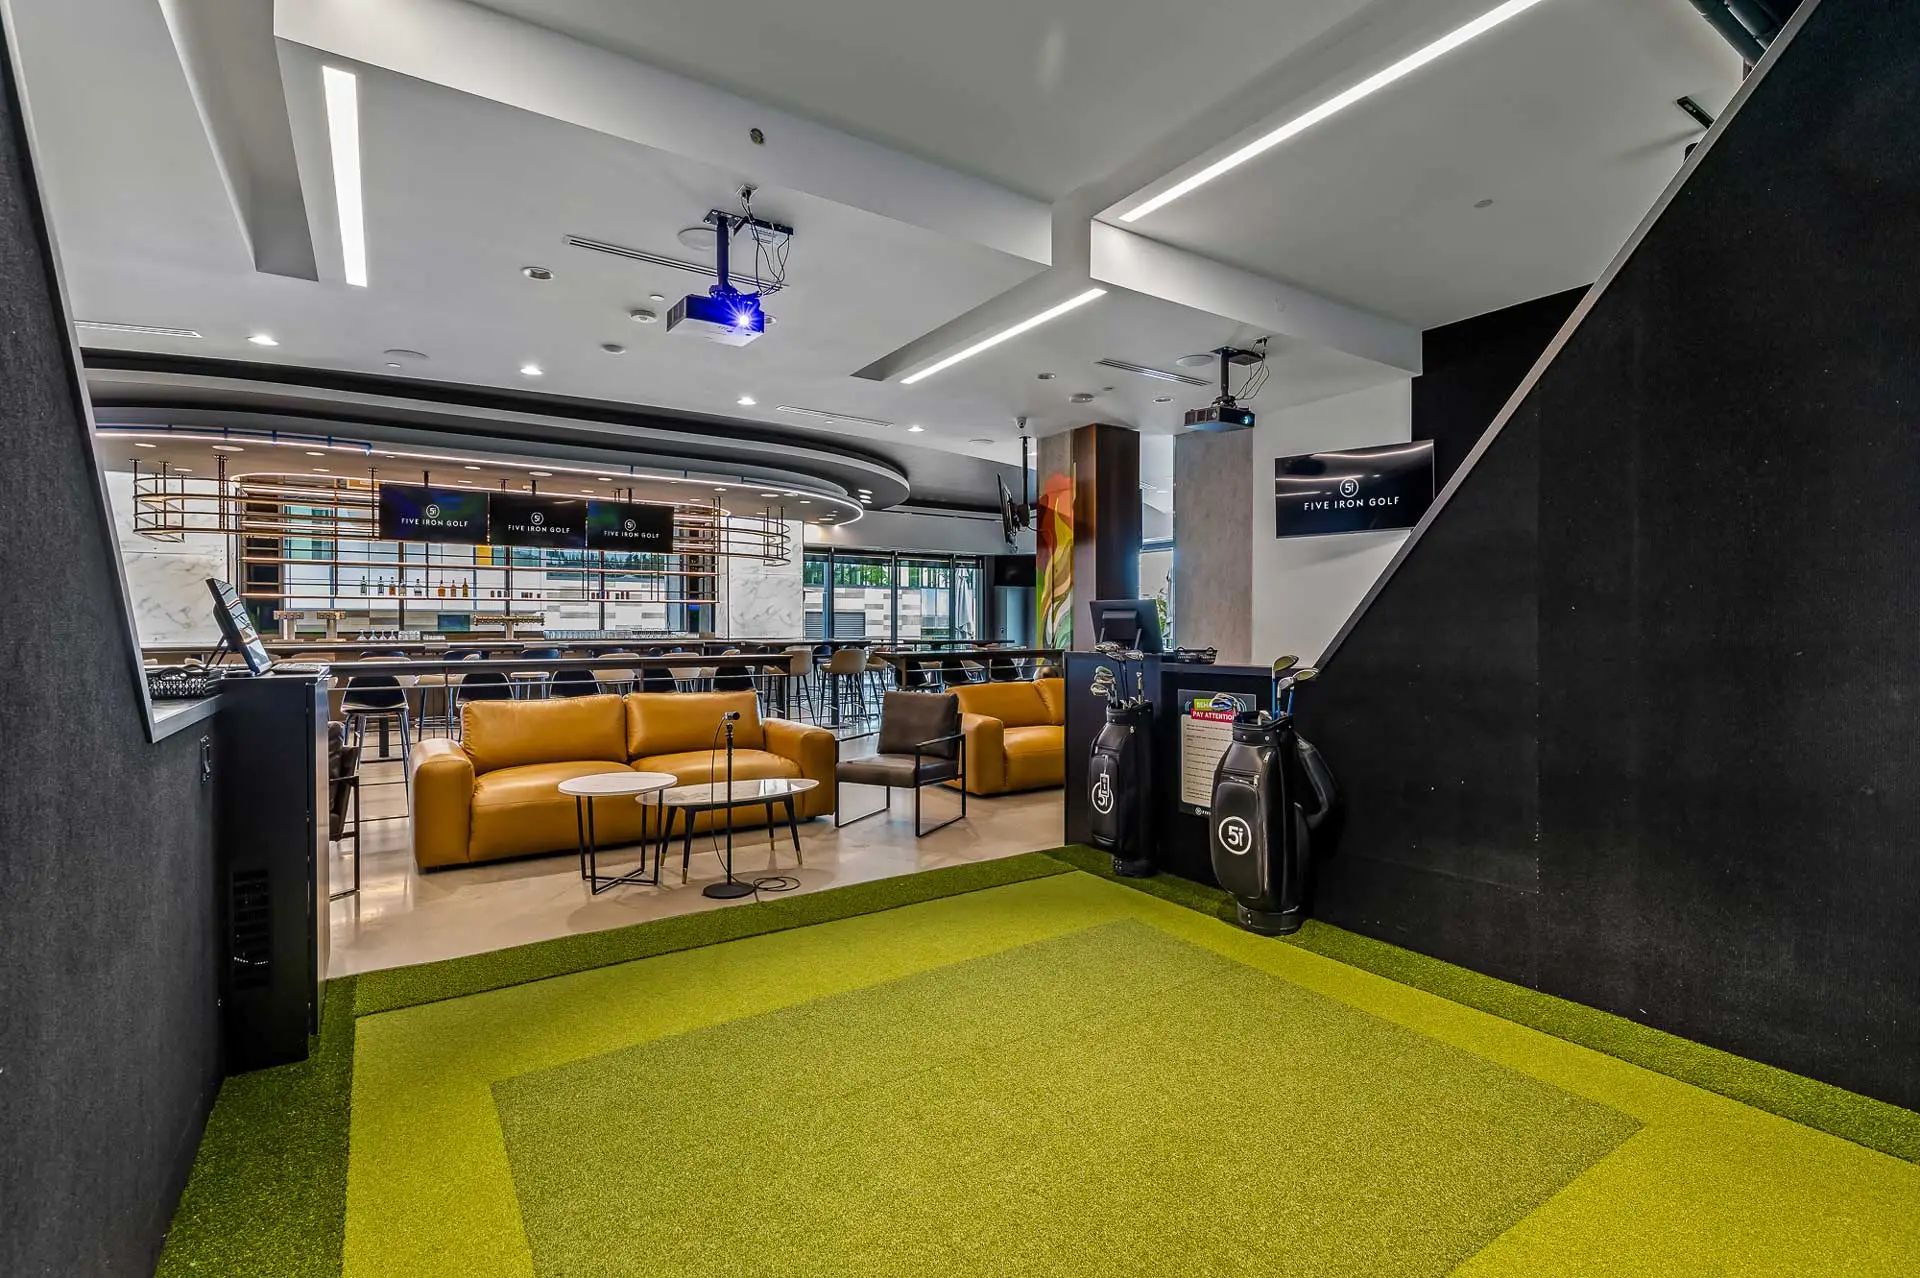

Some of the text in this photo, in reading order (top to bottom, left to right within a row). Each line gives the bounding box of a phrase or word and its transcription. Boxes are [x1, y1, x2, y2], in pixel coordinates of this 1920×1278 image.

[1304, 496, 1400, 511] FIVE IRON GOLF
[401, 517, 419, 525] FIVE
[550, 526, 570, 534] GOLF
[1192, 710, 1235, 721] PAY ATTENTIO
